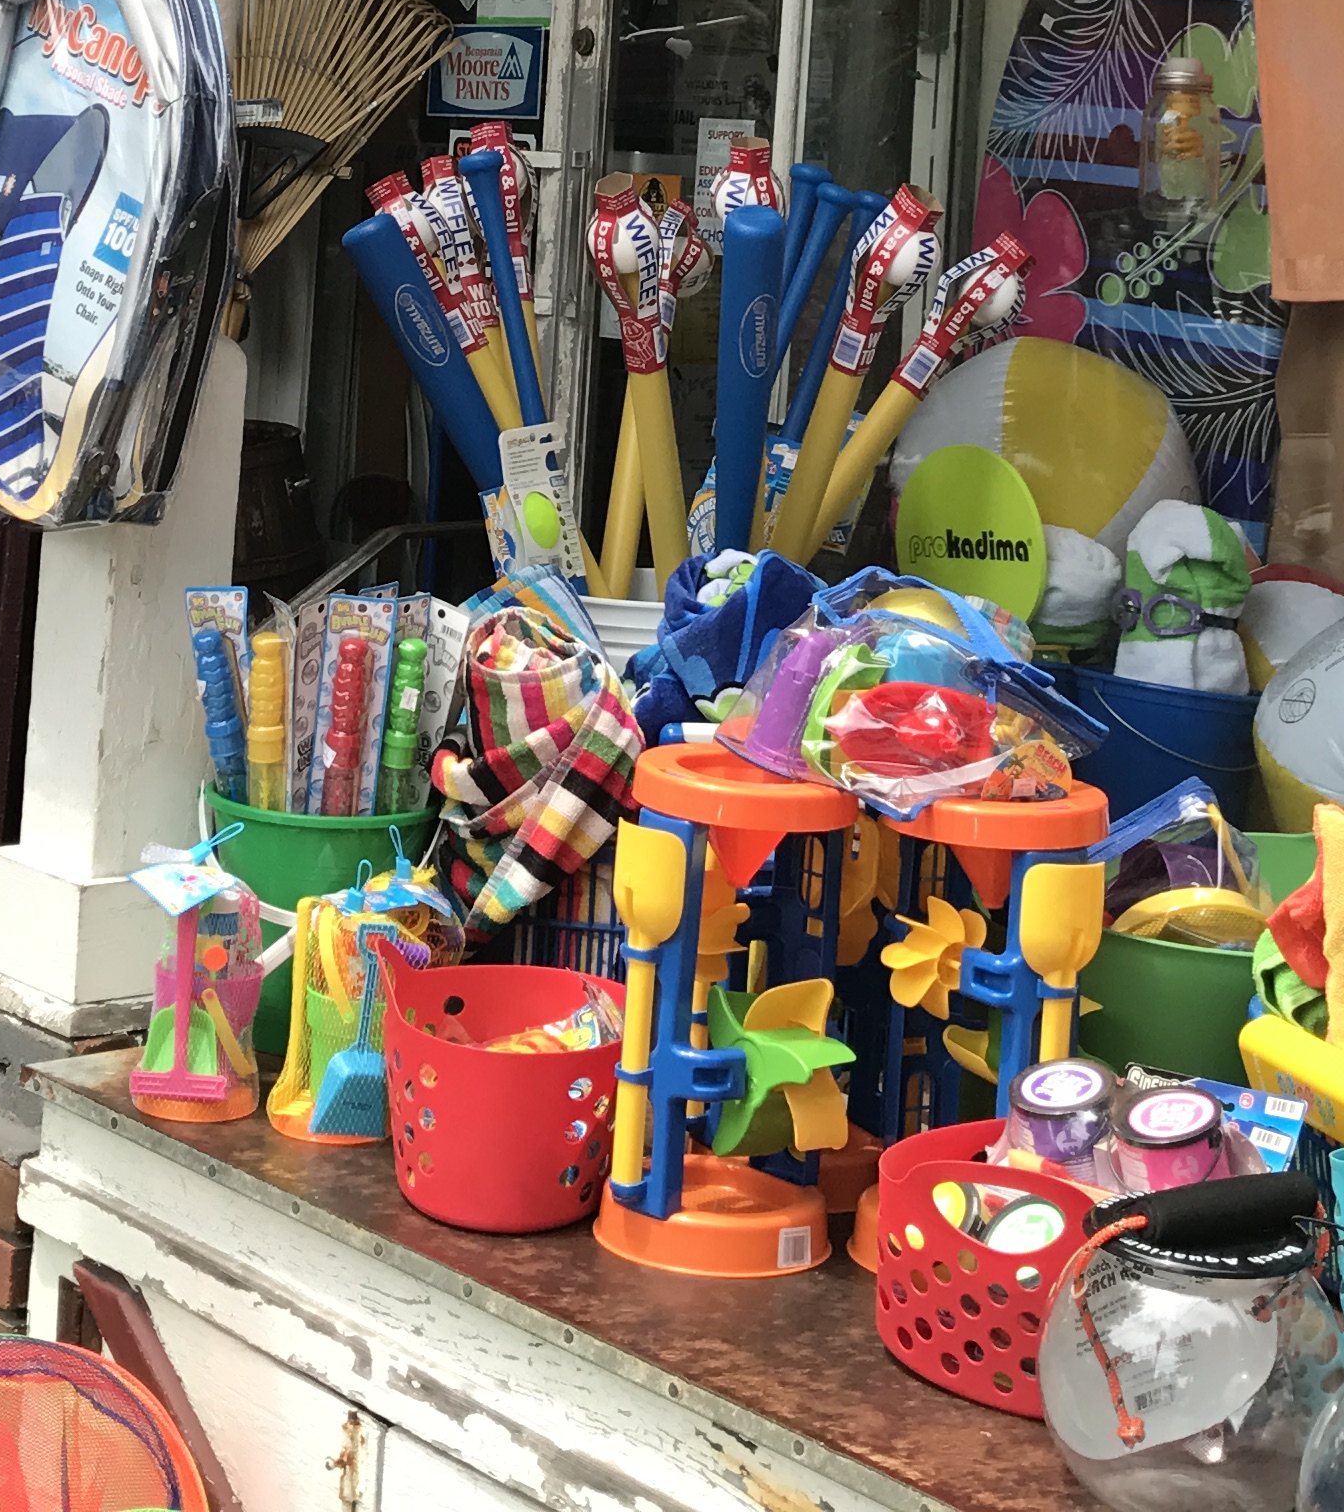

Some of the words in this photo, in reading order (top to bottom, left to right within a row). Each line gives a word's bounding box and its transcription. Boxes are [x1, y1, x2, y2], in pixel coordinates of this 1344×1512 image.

[446, 52, 500, 77] Moore
[465, 46, 503, 58] Benjamin
[96, 76, 128, 109] Shade
[455, 78, 510, 101] PAINTS
[505, 195, 519, 233] ball
[597, 221, 613, 259] bat
[879, 224, 910, 260] bat
[79, 259, 104, 283] Snaps
[104, 274, 125, 296] Righ
[418, 255, 443, 291] ball
[600, 264, 613, 277] &
[868, 261, 884, 276] &
[75, 280, 96, 301] Onto
[97, 292, 117, 312] Your
[606, 280, 632, 310] ball
[860, 278, 877, 312] ball
[969, 287, 986, 301] &
[75, 303, 99, 326] Chair.
[946, 302, 975, 335] ball
[1118, 1236, 1239, 1266] Aquarium
[1247, 1245, 1302, 1265] Beach
